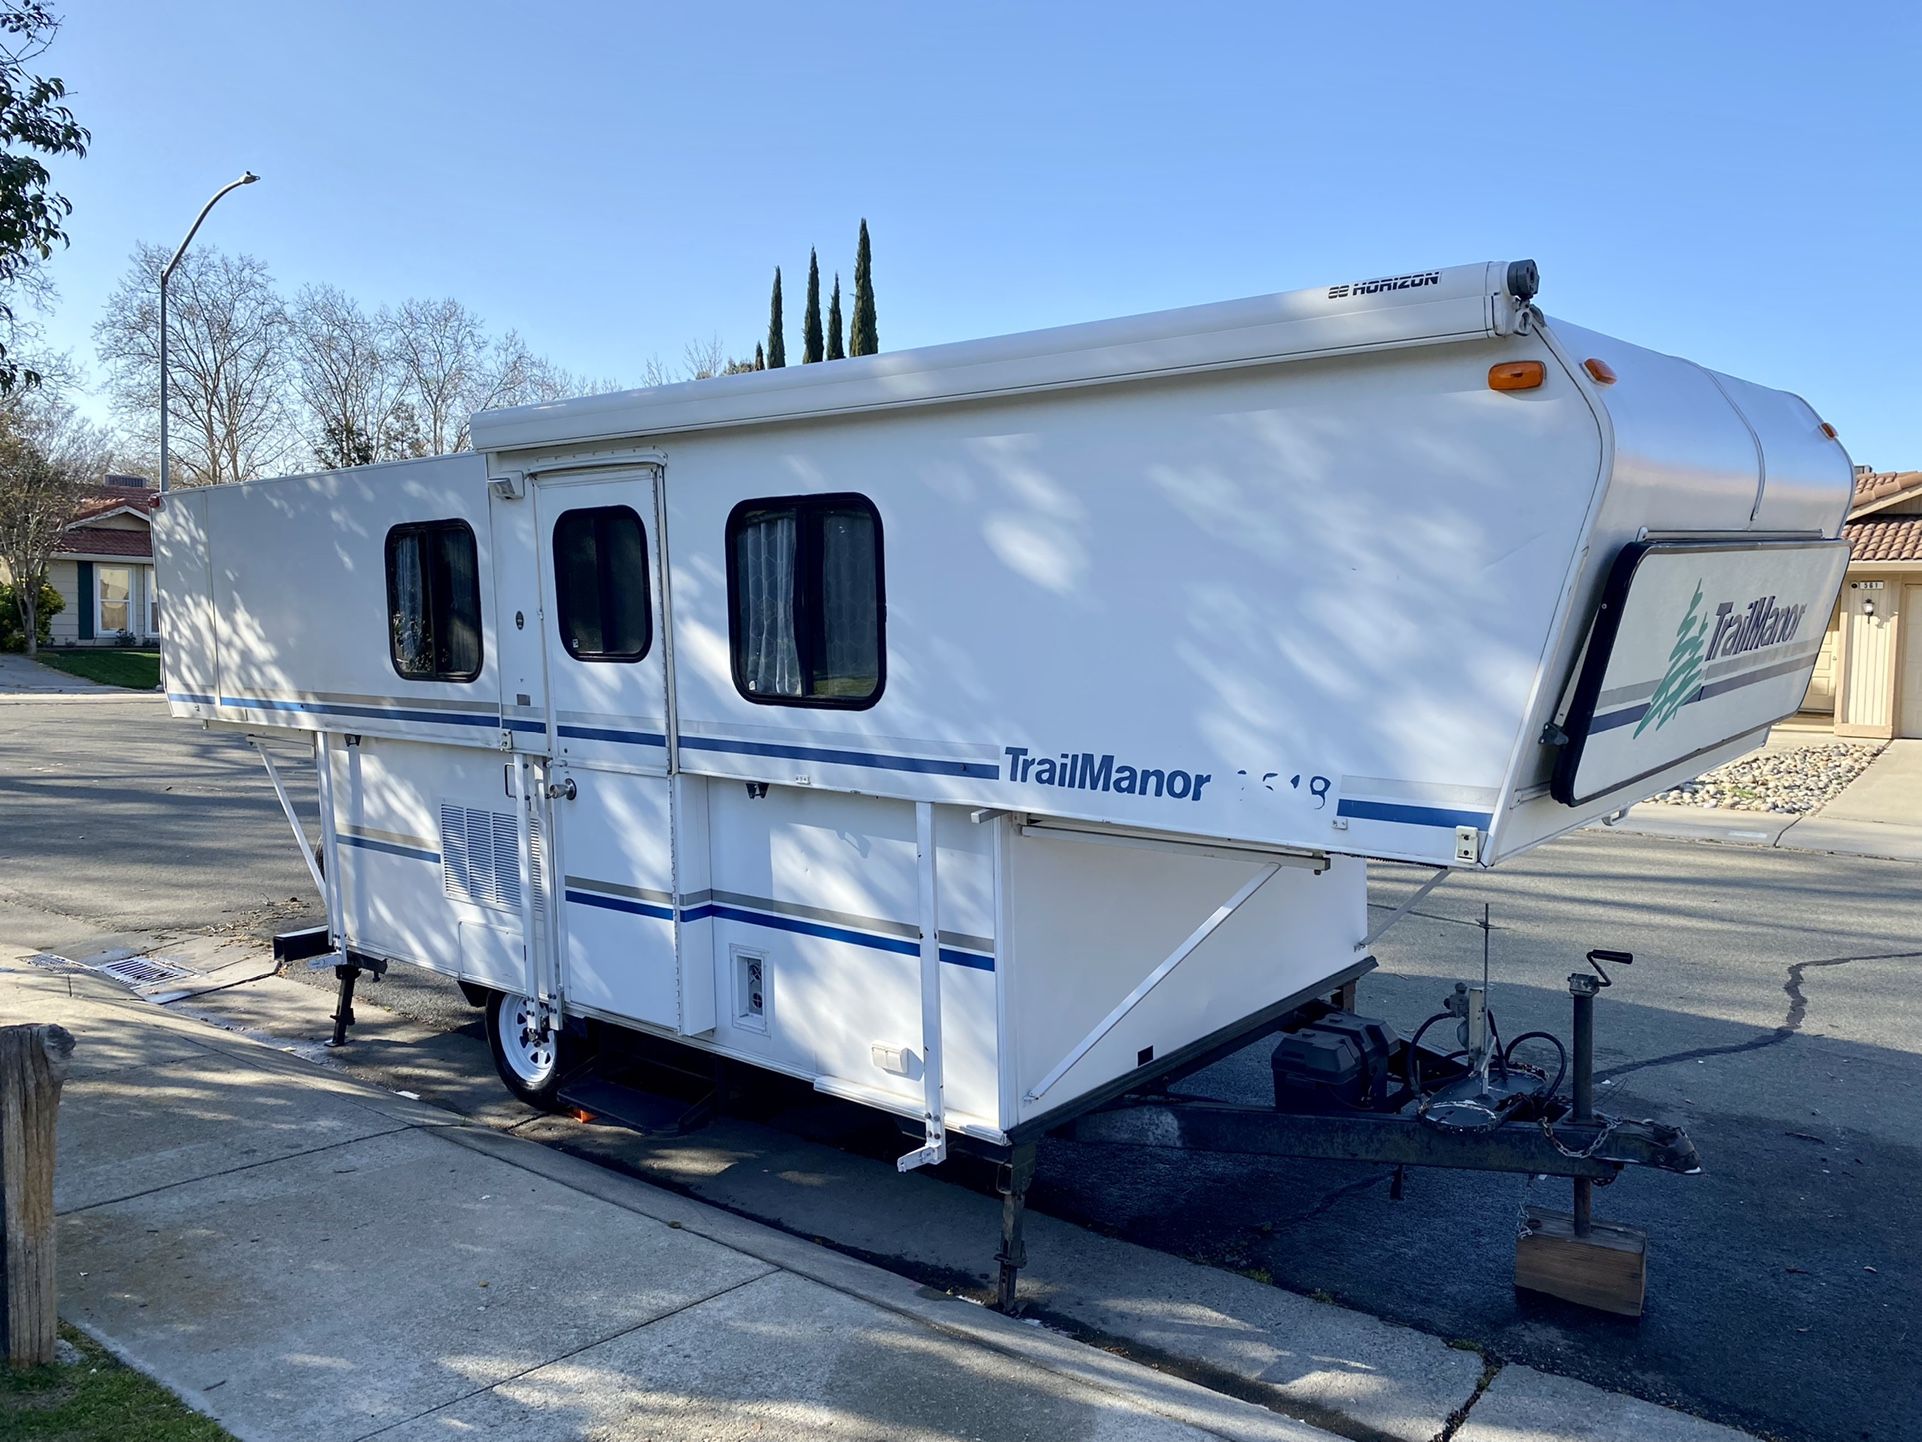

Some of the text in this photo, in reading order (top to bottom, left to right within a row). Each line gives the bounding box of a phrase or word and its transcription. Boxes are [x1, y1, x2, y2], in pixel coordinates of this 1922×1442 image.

[1352, 271, 1440, 296] HORIZON
[1705, 595, 1807, 662] TrailManor
[1004, 746, 1212, 802] TrailManor
